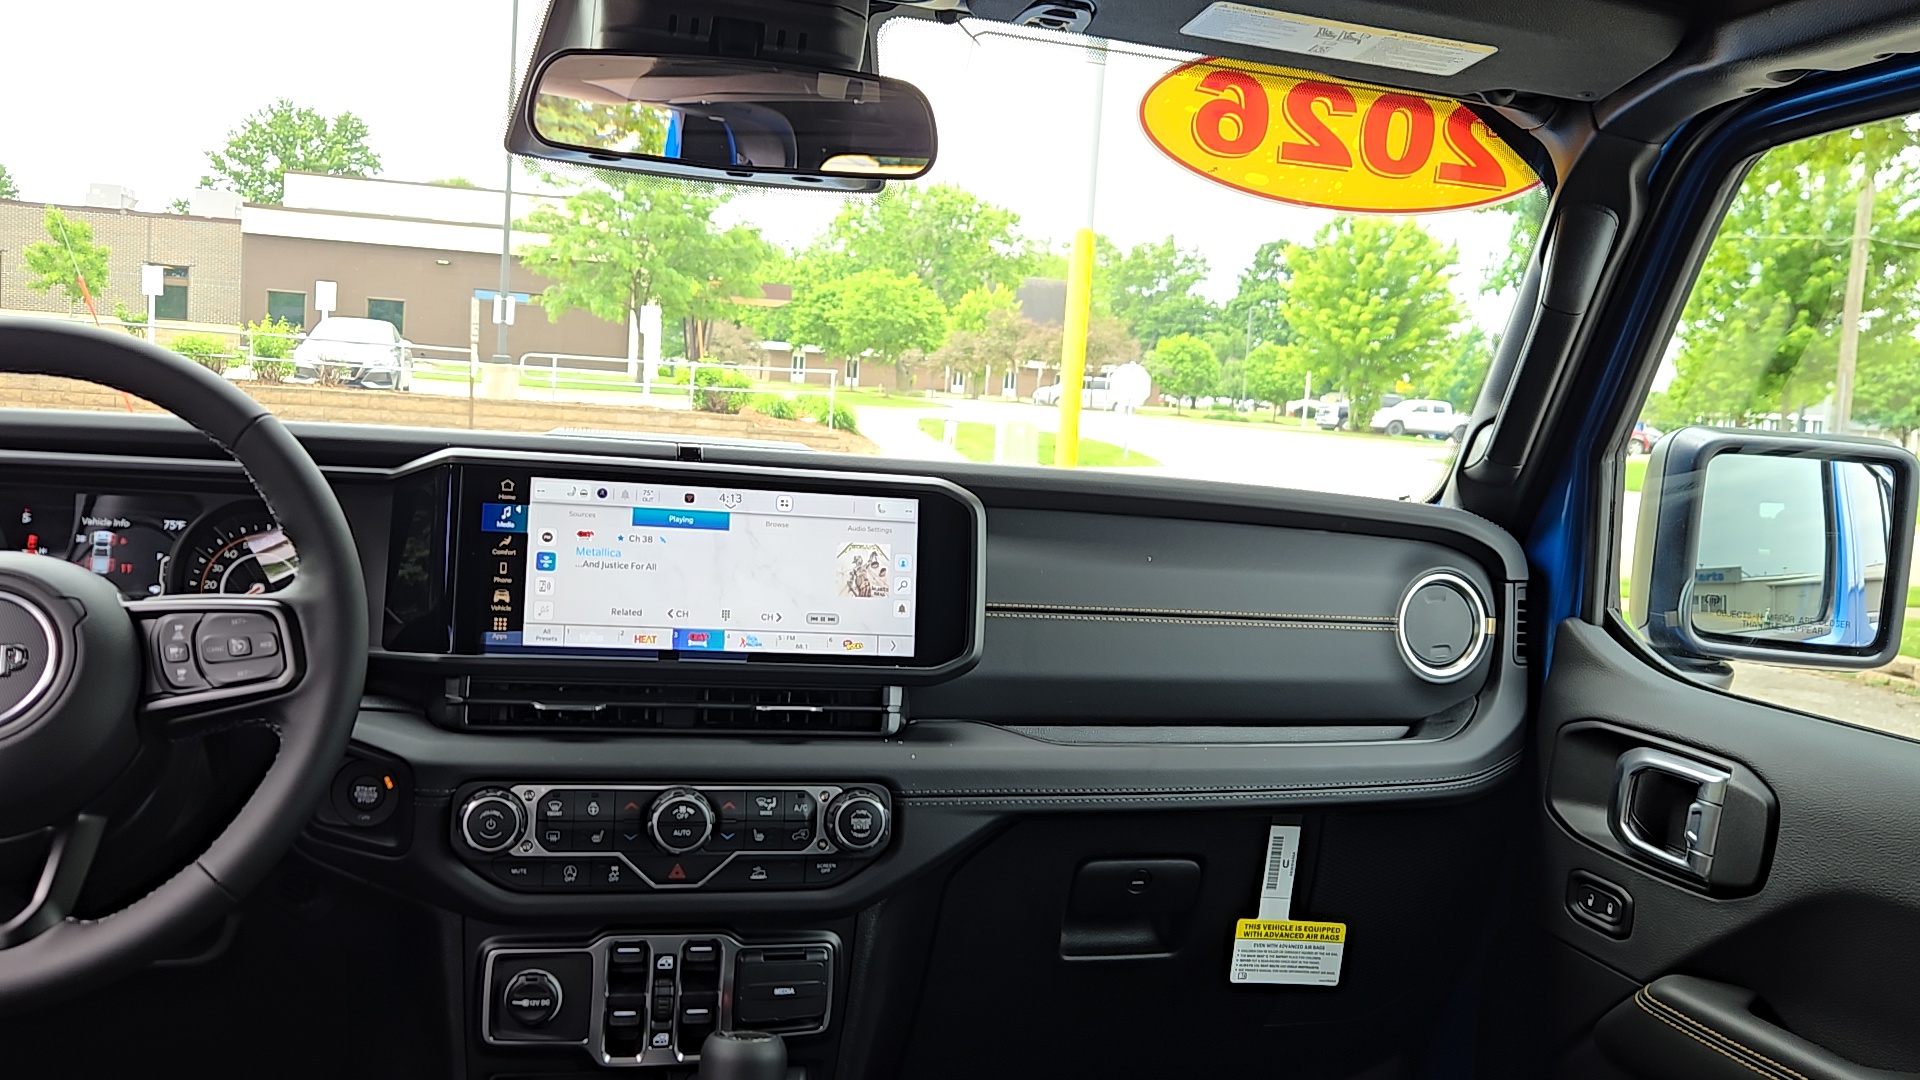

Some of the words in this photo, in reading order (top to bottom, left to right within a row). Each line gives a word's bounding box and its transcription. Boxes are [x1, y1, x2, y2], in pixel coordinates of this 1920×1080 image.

[498, 493, 516, 501] Home
[719, 493, 742, 504] 4:13
[568, 511, 596, 519] Sources
[668, 514, 694, 525] Playing
[81, 516, 111, 527] Vehicle
[113, 518, 131, 528] Info
[496, 520, 515, 529] Media
[765, 521, 789, 529] Browse
[867, 526, 893, 535] Settings
[628, 534, 640, 543] Ch
[642, 535, 653, 543] 38
[223, 549, 238, 559] 40
[492, 548, 516, 556] Comfort
[576, 546, 621, 558] Metallica
[212, 564, 224, 574] 30
[601, 560, 629, 570] Justice
[630, 562, 645, 570] For
[646, 563, 657, 571] All
[204, 579, 218, 590] 20
[493, 576, 512, 584] Phone
[491, 604, 512, 612] Vehicle
[611, 608, 643, 617] Related
[676, 610, 689, 618] CH
[761, 613, 774, 621] CH
[492, 632, 508, 641] Apps
[634, 634, 657, 644] HEAT
[793, 803, 808, 812] A/C
[673, 829, 691, 837] AUTO
[1282, 859, 1290, 868] U
[1244, 923, 1261, 931] THIS
[1263, 924, 1293, 932] VEHICLE
[1303, 925, 1340, 934] EQUIPPED
[1243, 930, 1262, 938] WITH
[1264, 931, 1304, 939] ADVANCED
[1305, 932, 1318, 940] AIR
[1320, 933, 1340, 941] BAGS
[773, 987, 795, 995] MEDIA
